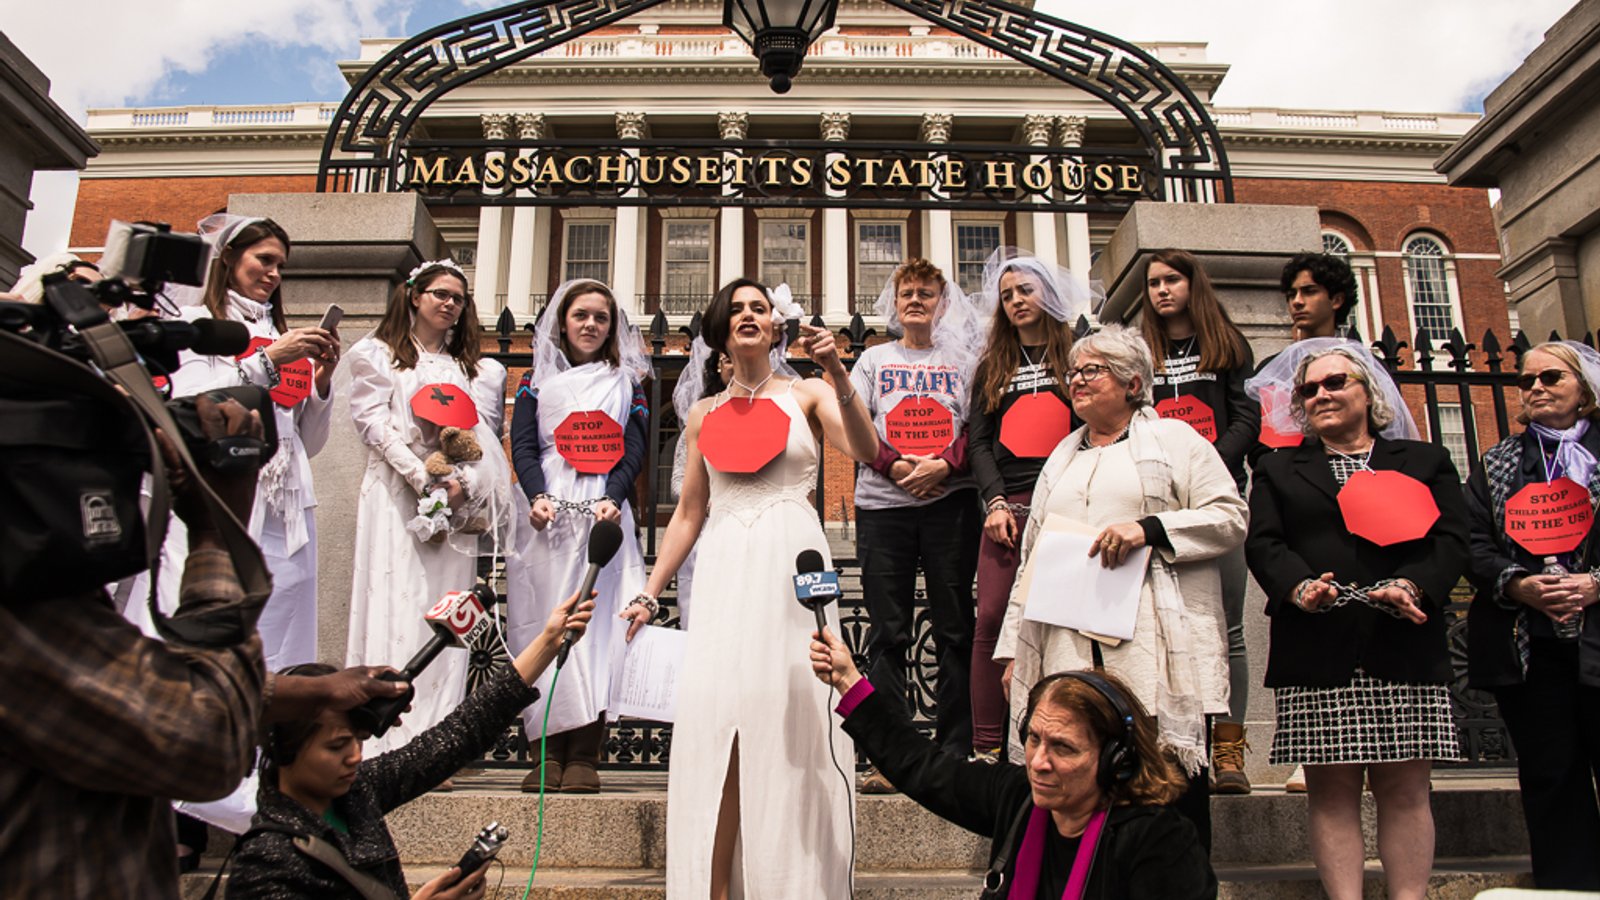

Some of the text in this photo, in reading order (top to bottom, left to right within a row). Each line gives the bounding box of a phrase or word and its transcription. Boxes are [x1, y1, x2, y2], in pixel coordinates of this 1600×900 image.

[409, 155, 1144, 192] MASSACHUSETTS STATE HOUSE
[286, 377, 308, 390] US!
[879, 368, 960, 397] STAFF
[903, 408, 935, 417] STOP
[1162, 406, 1194, 418] STOP
[572, 420, 604, 431] STOP
[887, 418, 951, 428] CHILD MARRIAGE
[556, 431, 621, 441] CHILD MARRIAGE
[889, 428, 951, 440] IN THE US!
[559, 442, 621, 453] IN THE US!
[1530, 489, 1569, 504] STOP
[1508, 497, 1589, 516] CHILD MARRIAGE
[1510, 509, 1590, 531] IN THE US!
[463, 617, 489, 645] WCVB
